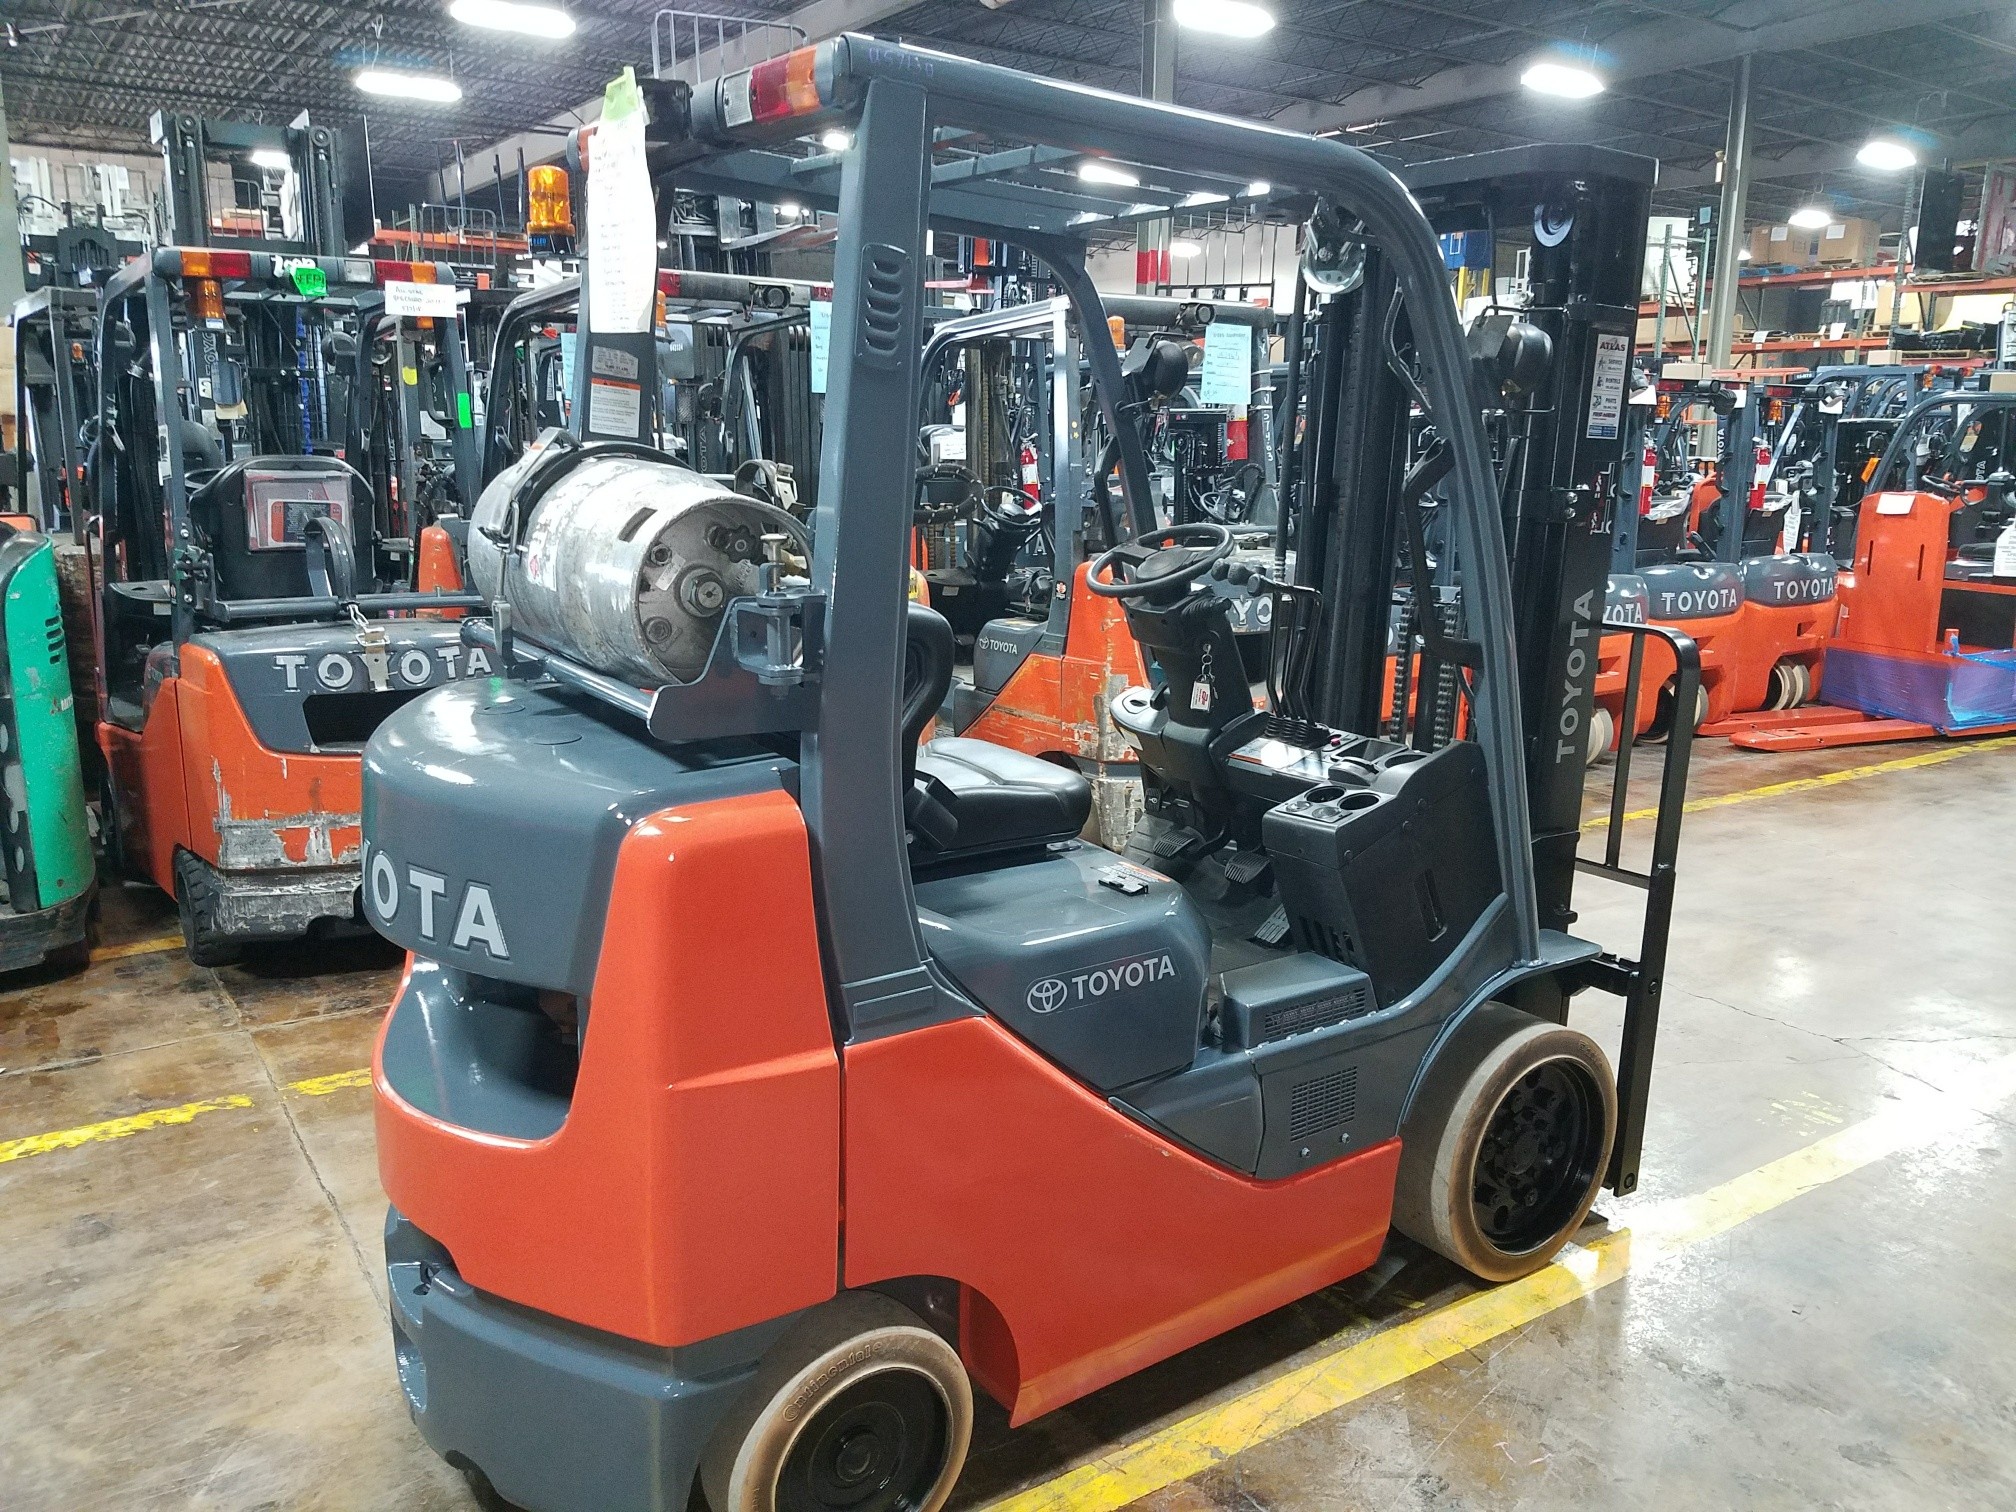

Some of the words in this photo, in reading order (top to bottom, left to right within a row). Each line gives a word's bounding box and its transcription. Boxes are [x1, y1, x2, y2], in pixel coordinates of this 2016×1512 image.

[1600, 341, 1626, 351] ATLAS
[1661, 588, 1738, 614] TOYOTA
[1773, 577, 1834, 600] TOYOTA
[989, 640, 1018, 655] TOYOTA
[1555, 589, 1594, 763] TOYOTA
[362, 839, 510, 958] OTA
[1072, 955, 1175, 1000] TOYOTA
